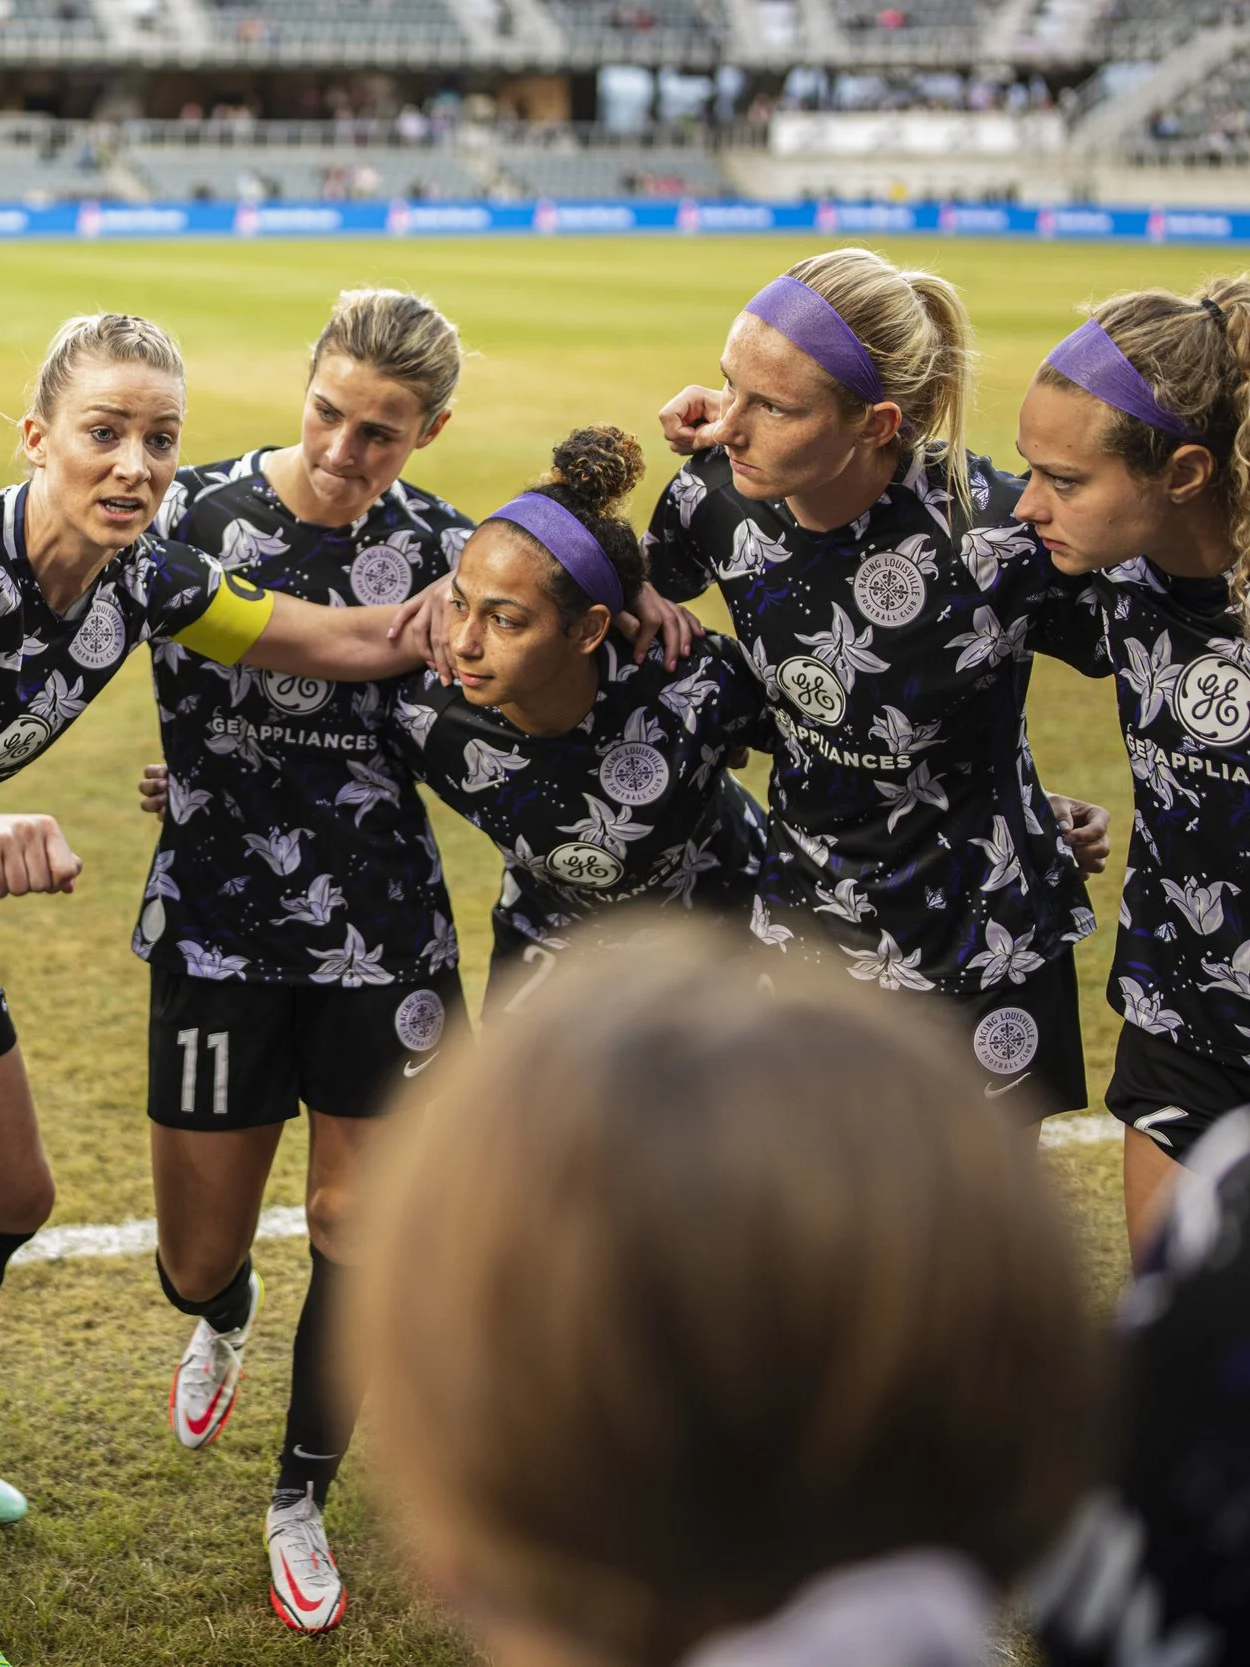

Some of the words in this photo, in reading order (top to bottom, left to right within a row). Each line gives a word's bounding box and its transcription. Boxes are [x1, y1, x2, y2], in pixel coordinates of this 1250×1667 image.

[356, 550, 378, 575] RACING
[380, 550, 408, 585] LOUISVILLE
[859, 560, 882, 588] RACING
[885, 558, 920, 596] LOUISVILLE
[92, 605, 122, 636] LOUISVILLE
[860, 594, 897, 620] FOOTBALL
[900, 601, 917, 618] CLUB
[106, 642, 120, 659] CLUB
[212, 717, 239, 734] GE
[247, 724, 378, 750] APPLIANCES
[789, 720, 912, 770] APPLIANCES
[1126, 733, 1147, 759] GE
[604, 752, 623, 779] RACING
[625, 746, 664, 774] LOUISVILLE
[608, 783, 647, 800] FOOTBALL
[649, 778, 663, 794] CLUB
[978, 1016, 998, 1046] RACING
[1000, 1012, 1034, 1039] LOUISVILLE
[176, 1027, 229, 1114] 11
[982, 1050, 1018, 1068] FOOTBALL
[1020, 1044, 1033, 1062] CLUB
